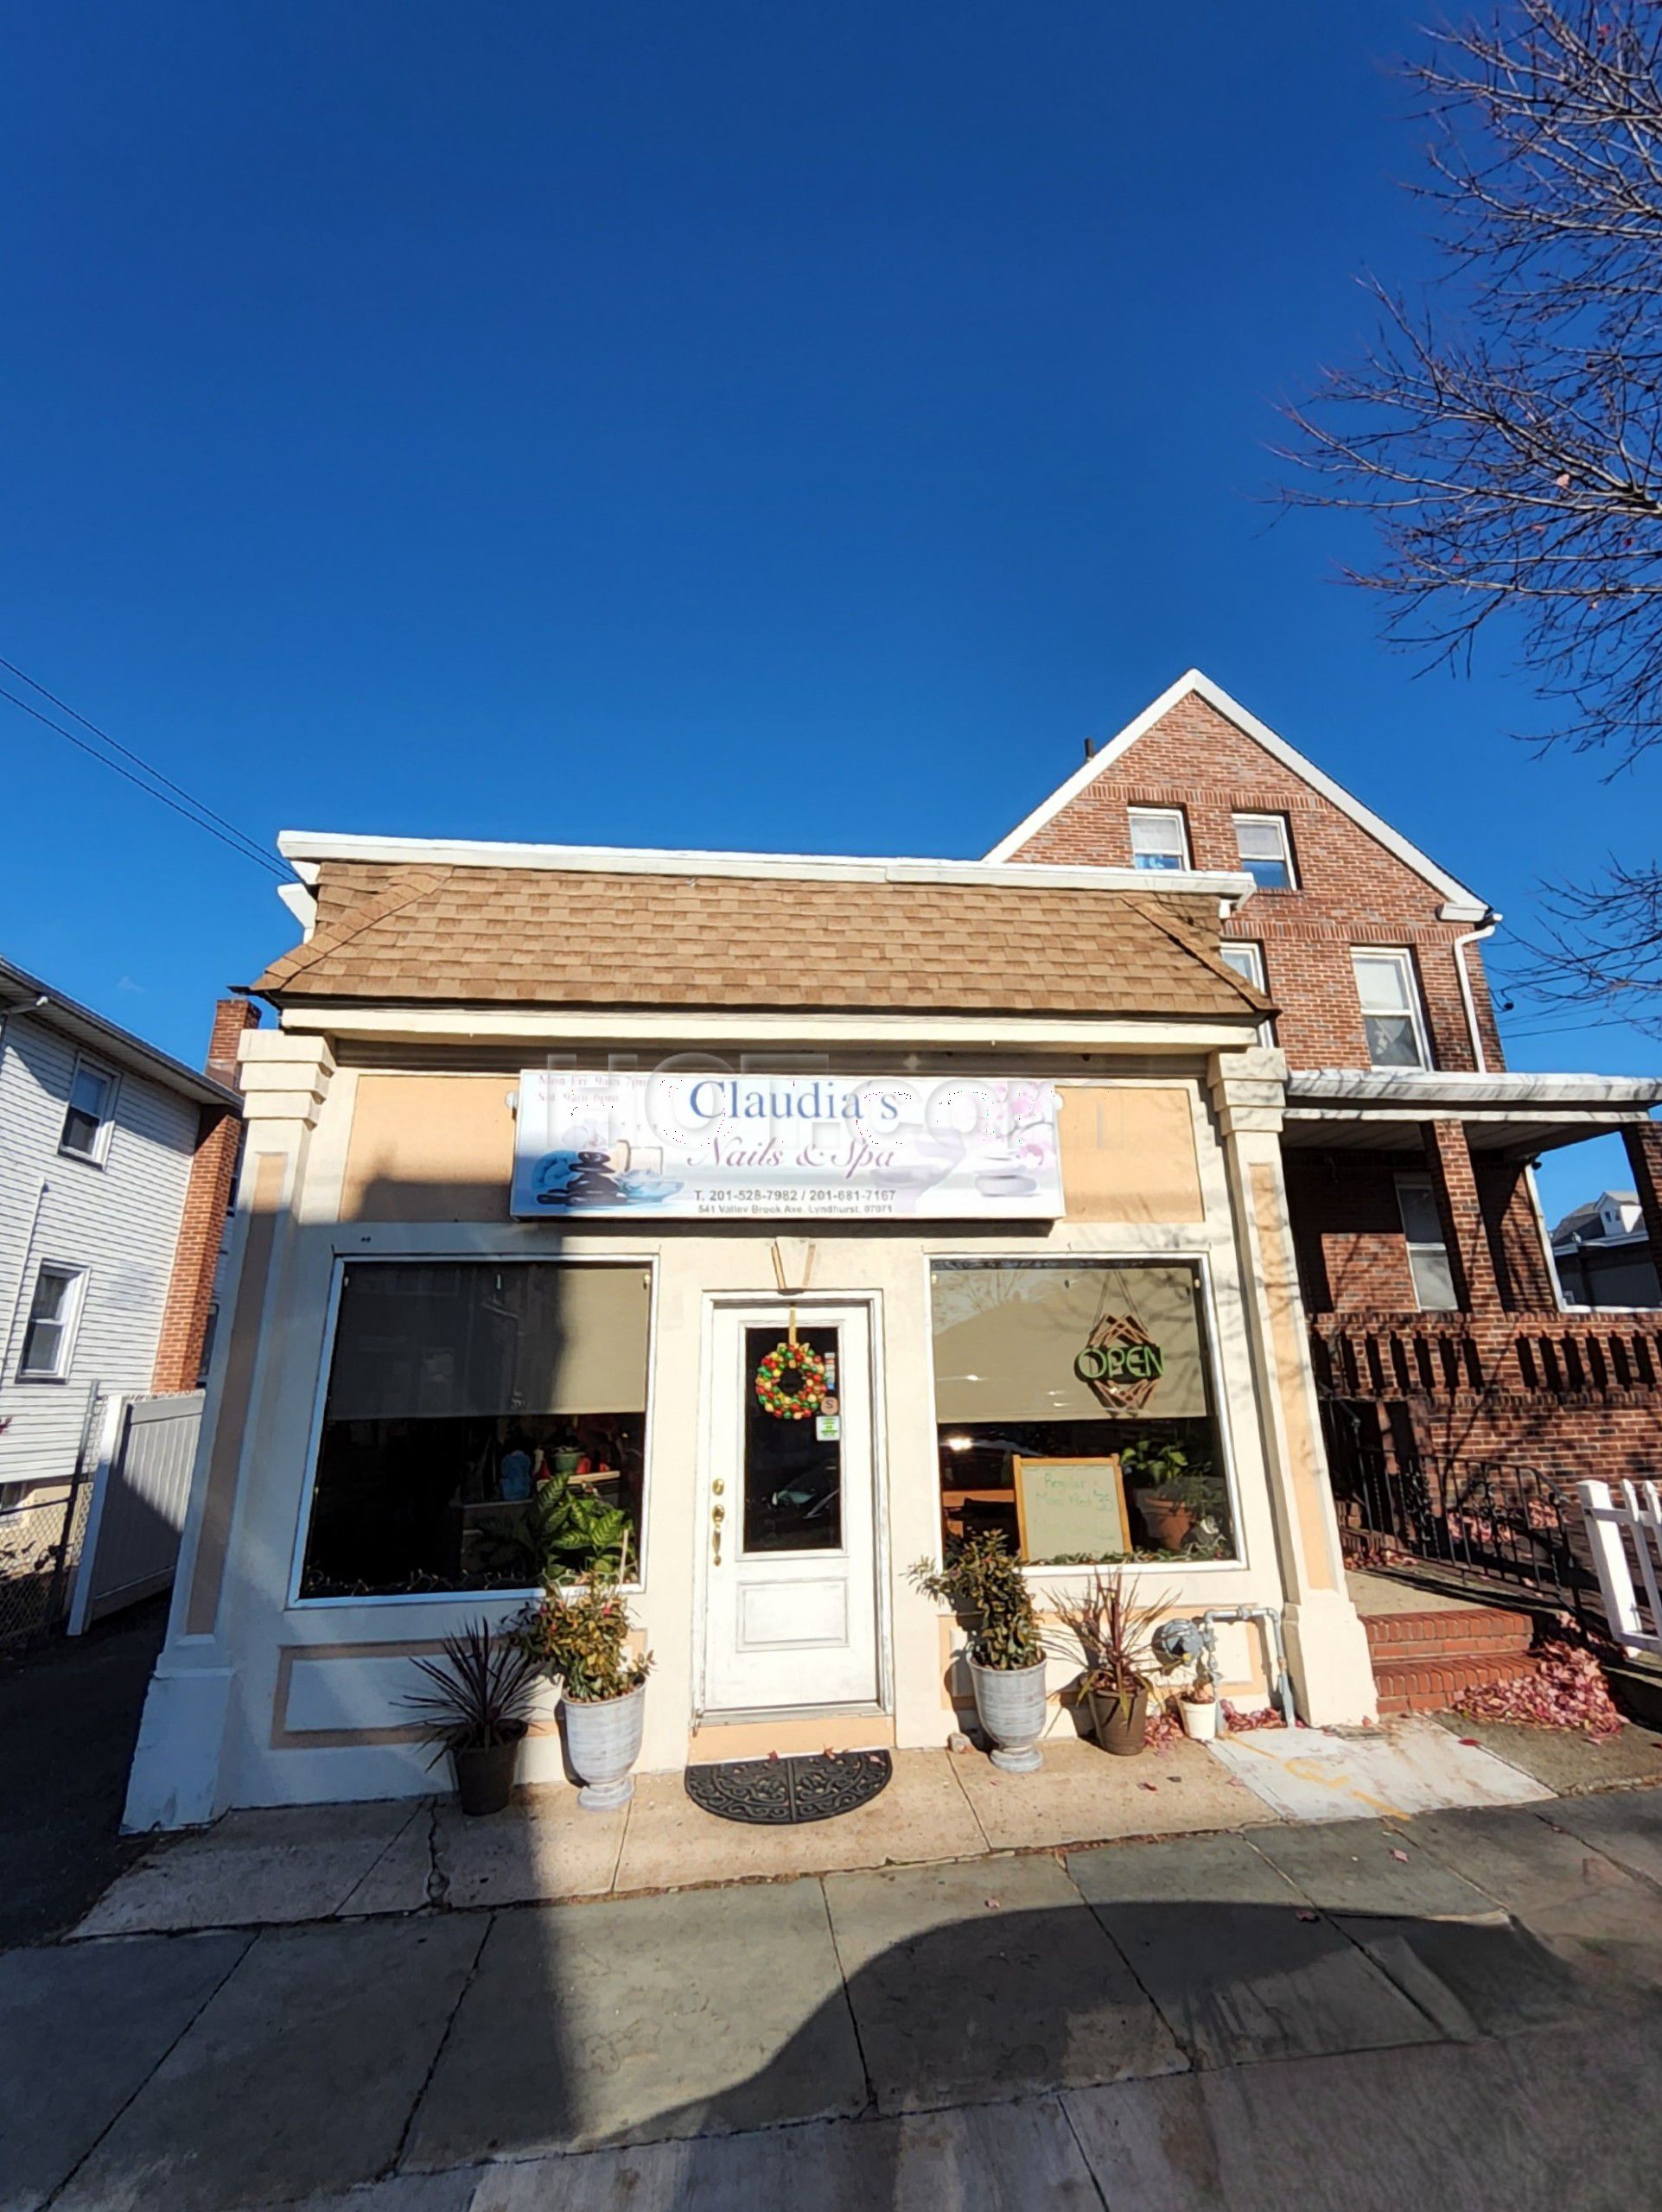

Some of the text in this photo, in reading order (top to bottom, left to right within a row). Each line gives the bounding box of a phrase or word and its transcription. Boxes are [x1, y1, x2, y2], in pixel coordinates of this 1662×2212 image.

[690, 1080, 899, 1120] Claudia's
[687, 1137, 895, 1179] Nails & Spa
[694, 1190, 705, 1201] T.
[1078, 1345, 1165, 1378] OPEN
